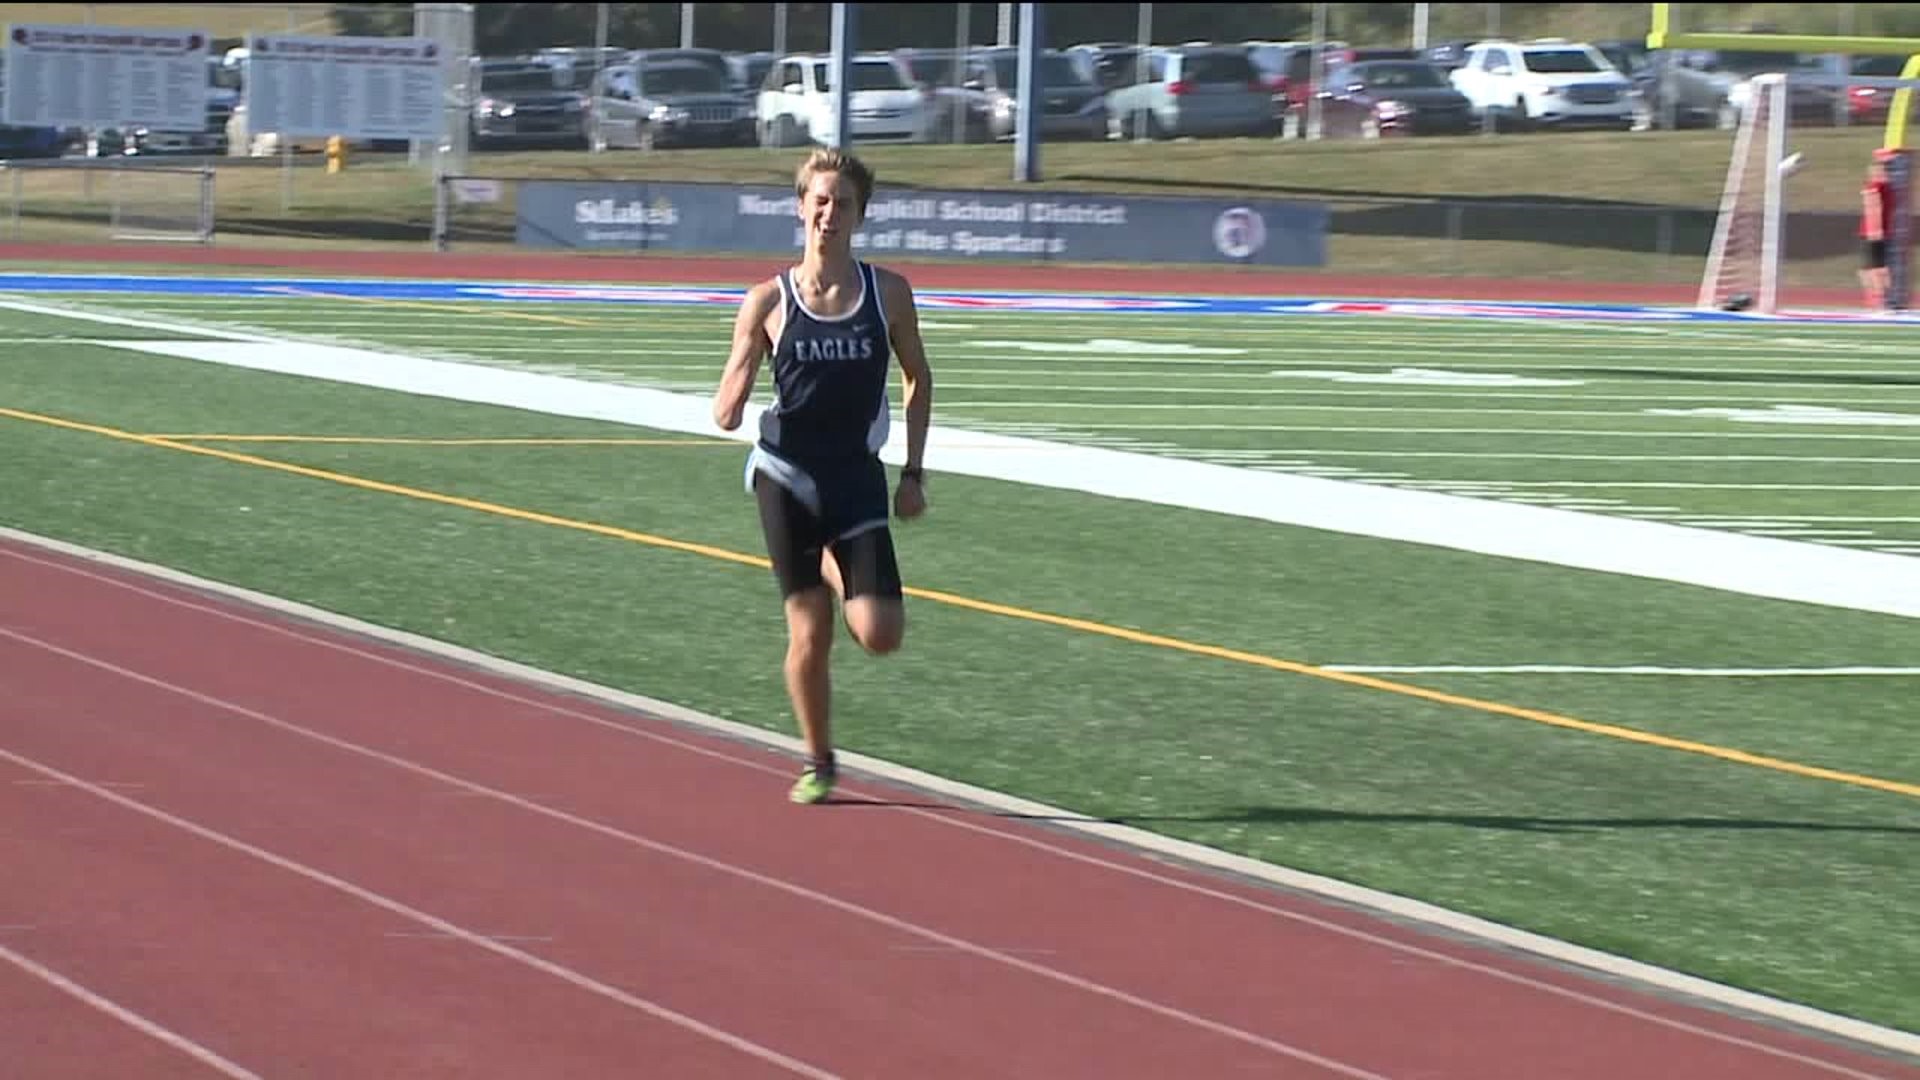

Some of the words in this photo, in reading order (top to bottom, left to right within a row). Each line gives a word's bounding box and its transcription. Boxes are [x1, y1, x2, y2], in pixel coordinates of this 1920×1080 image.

[738, 195, 798, 216] Nort
[940, 200, 1026, 221] School
[1028, 202, 1128, 223] District
[872, 229, 902, 249] of
[905, 229, 949, 250] the
[951, 230, 1067, 255] Spartans
[795, 337, 873, 360] EAGLES
